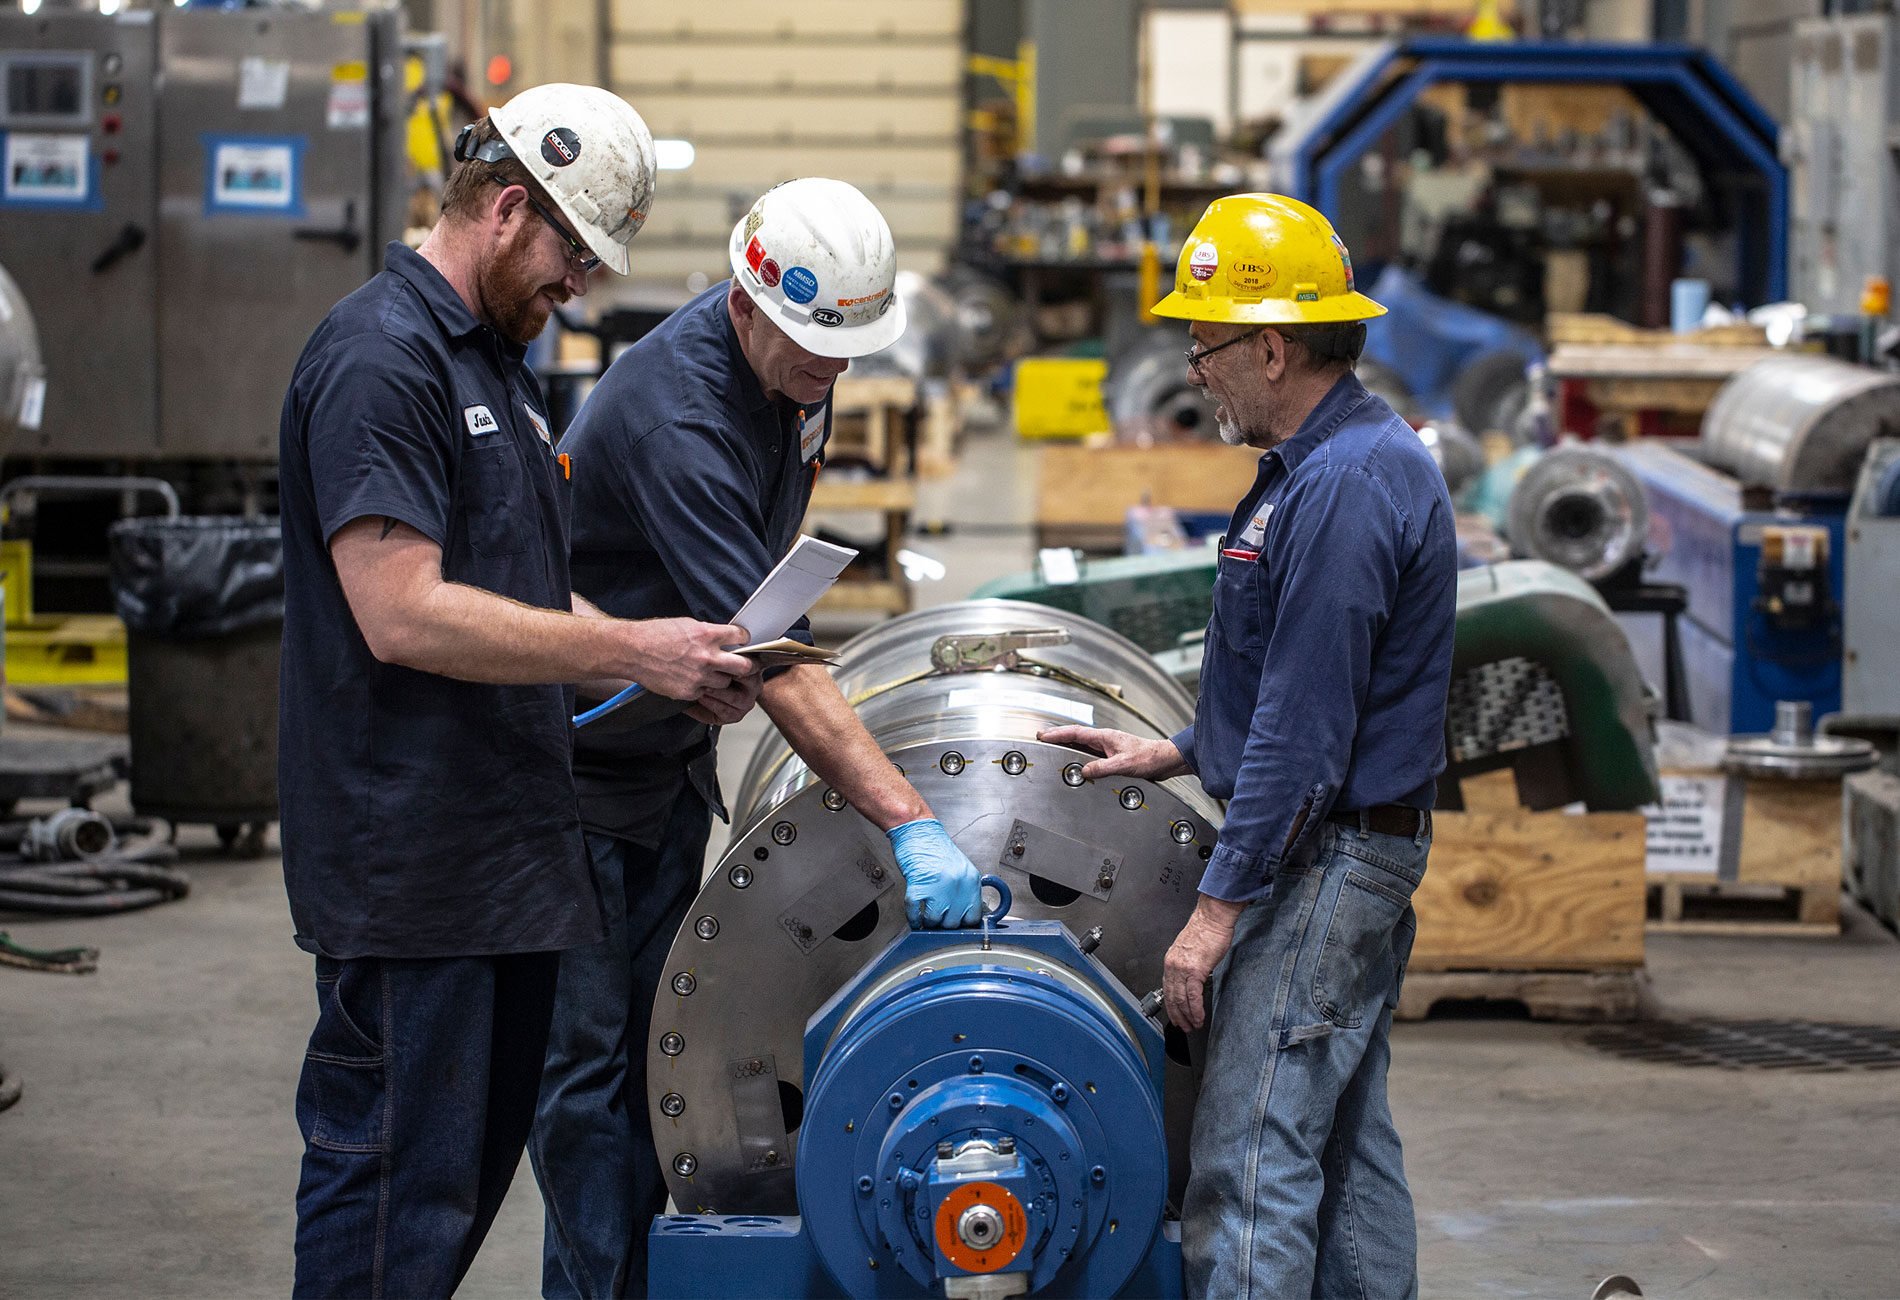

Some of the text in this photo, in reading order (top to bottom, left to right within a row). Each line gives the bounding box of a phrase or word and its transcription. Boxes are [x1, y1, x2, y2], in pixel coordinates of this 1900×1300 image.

[548, 131, 574, 160] RIDGID
[1239, 263, 1265, 273] JBS
[793, 269, 815, 287] MMSD
[1233, 280, 1250, 290] SAFETY
[816, 312, 838, 324] ZLA
